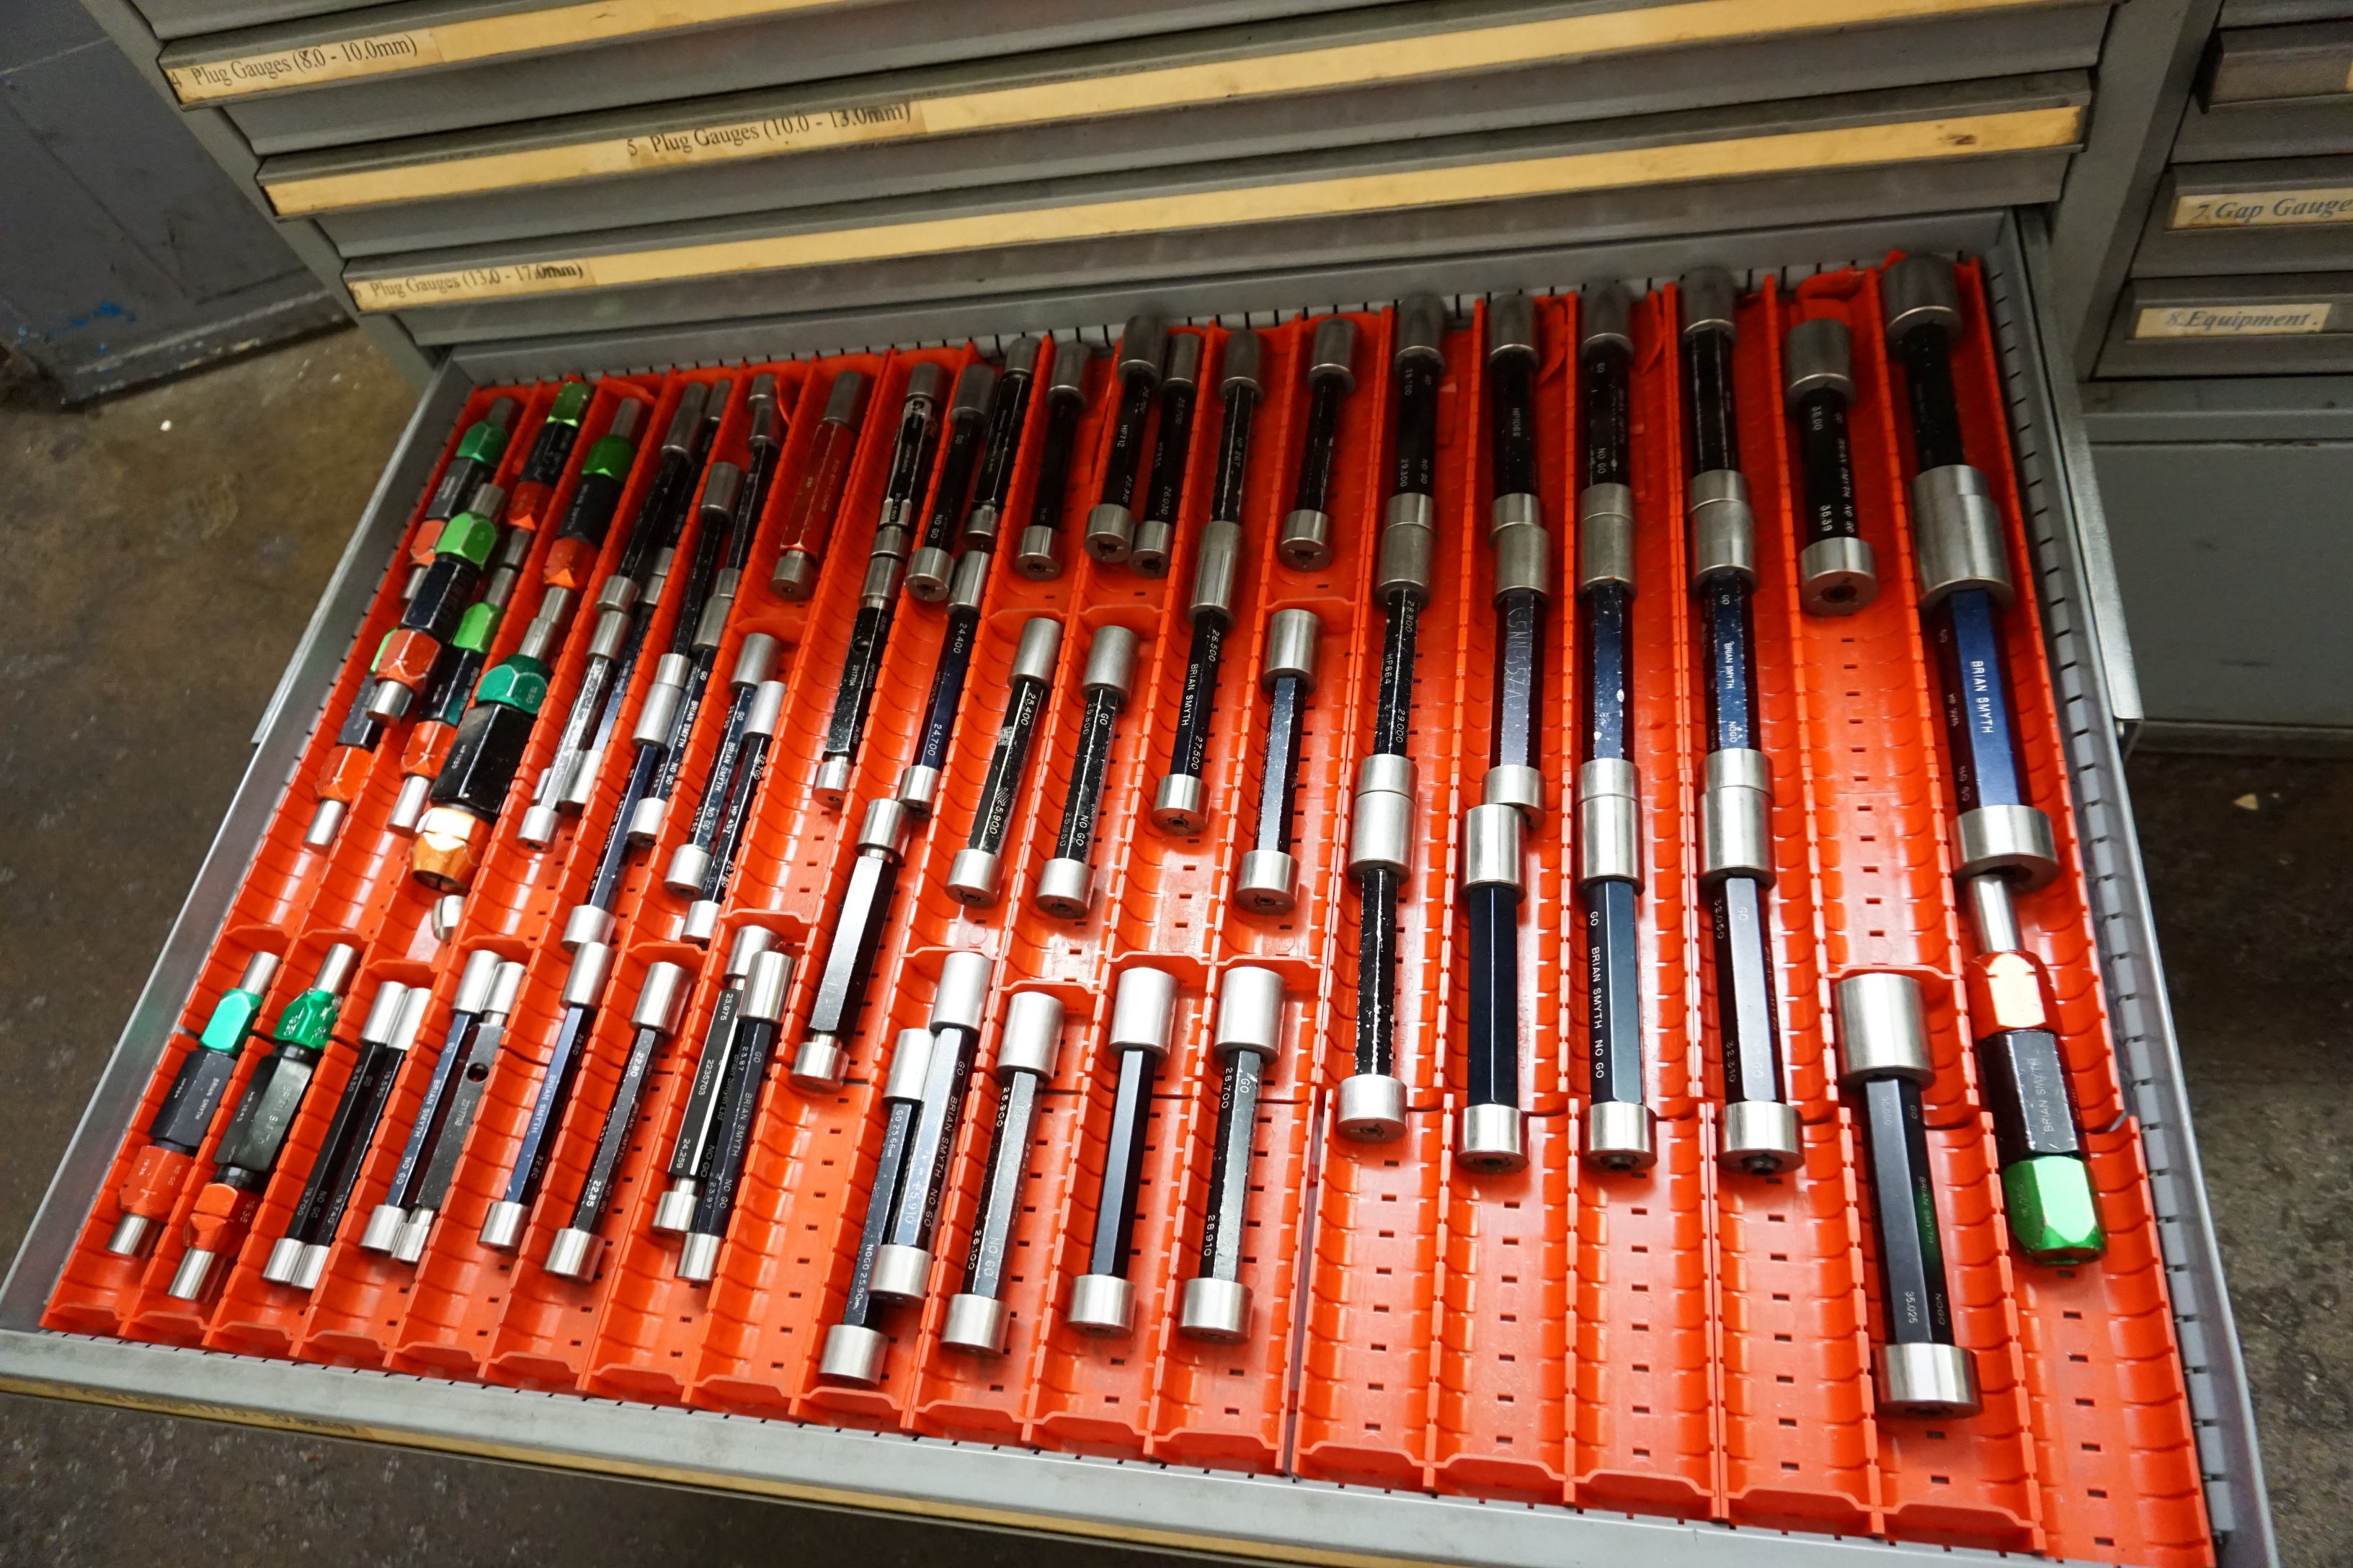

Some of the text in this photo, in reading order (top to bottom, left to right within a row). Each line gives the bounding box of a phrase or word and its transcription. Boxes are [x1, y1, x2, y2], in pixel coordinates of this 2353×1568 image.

[190, 67, 233, 86] Plug
[231, 56, 292, 80] Gauges
[342, 34, 418, 63] 10.0mm)
[626, 138, 638, 156] 5
[649, 133, 692, 153] Plug
[693, 124, 760, 147] Gauges
[762, 115, 809, 141] (10.0
[829, 102, 912, 128] 13.0mm)
[2215, 201, 2264, 223] Gap
[2272, 197, 2353, 218] Gauge
[370, 282, 406, 298] Plug
[405, 274, 461, 295] Gauges
[462, 267, 500, 290] (13.0
[1116, 423, 1129, 448] HP712
[1512, 407, 1521, 436] HP1068
[1597, 447, 1605, 458] NO
[1597, 463, 1606, 473] GO
[930, 433, 964, 538] GO NO GO
[1400, 458, 1408, 486] 29.300
[1160, 485, 1172, 515] 26.030
[1843, 503, 1853, 517] NO
[1845, 520, 1854, 533] GO
[1723, 642, 1733, 663] BRIAN
[1383, 653, 1394, 685] HP864
[1394, 600, 1415, 742] 28.800 29.000
[1724, 665, 1733, 688] SMYTH
[926, 622, 967, 757] 24.400 24.700
[1180, 663, 1198, 726] BRIAN SMYTH
[1190, 629, 1220, 770] 26.500 27.500
[1970, 660, 1993, 734] BRIAN SMYTH
[664, 669, 708, 785] GO BRIAN SMYTH NO GO
[701, 709, 745, 830] GO BRIAN SMYTH NO GO
[987, 692, 1036, 836] 25.400 25.900
[1073, 711, 1110, 847] GO NO GO
[729, 803, 739, 816] HP
[1589, 911, 1603, 1077] GO BRIAN SMYTH NO GO
[1738, 906, 1748, 920] GO
[1752, 1060, 1763, 1078] GO
[697, 1058, 714, 1096] 2235703
[1240, 1077, 1250, 1093] GO
[193, 1096, 210, 1122] SMYTH
[530, 1072, 557, 1134] BRIAN SMYTH
[2029, 1056, 2054, 1132] BRIAN SMYTH
[394, 1041, 455, 1185] GO BRIAN SMYTH NO GO
[894, 1109, 904, 1122] GO
[1908, 1104, 1917, 1120] GO
[584, 1050, 645, 1208] 22.80 22.85
[719, 1051, 762, 1208] GO BRIAN SMYTH NO GO
[923, 1061, 966, 1226] GO BRIAN SMYTH NO GO
[310, 1074, 373, 1219] GO NO GO
[703, 1144, 714, 1159] NO
[1204, 1066, 1233, 1257] 28.700 28.910
[699, 1160, 709, 1177] GO
[295, 1185, 313, 1216] 19.700
[704, 1181, 716, 1208] 23.97
[1918, 1176, 1929, 1206] BRIAN
[1923, 1210, 1934, 1244] SMYTH
[987, 1236, 1000, 1253] NO
[983, 1258, 995, 1275] GO
[1905, 1291, 1918, 1324] 35.025
